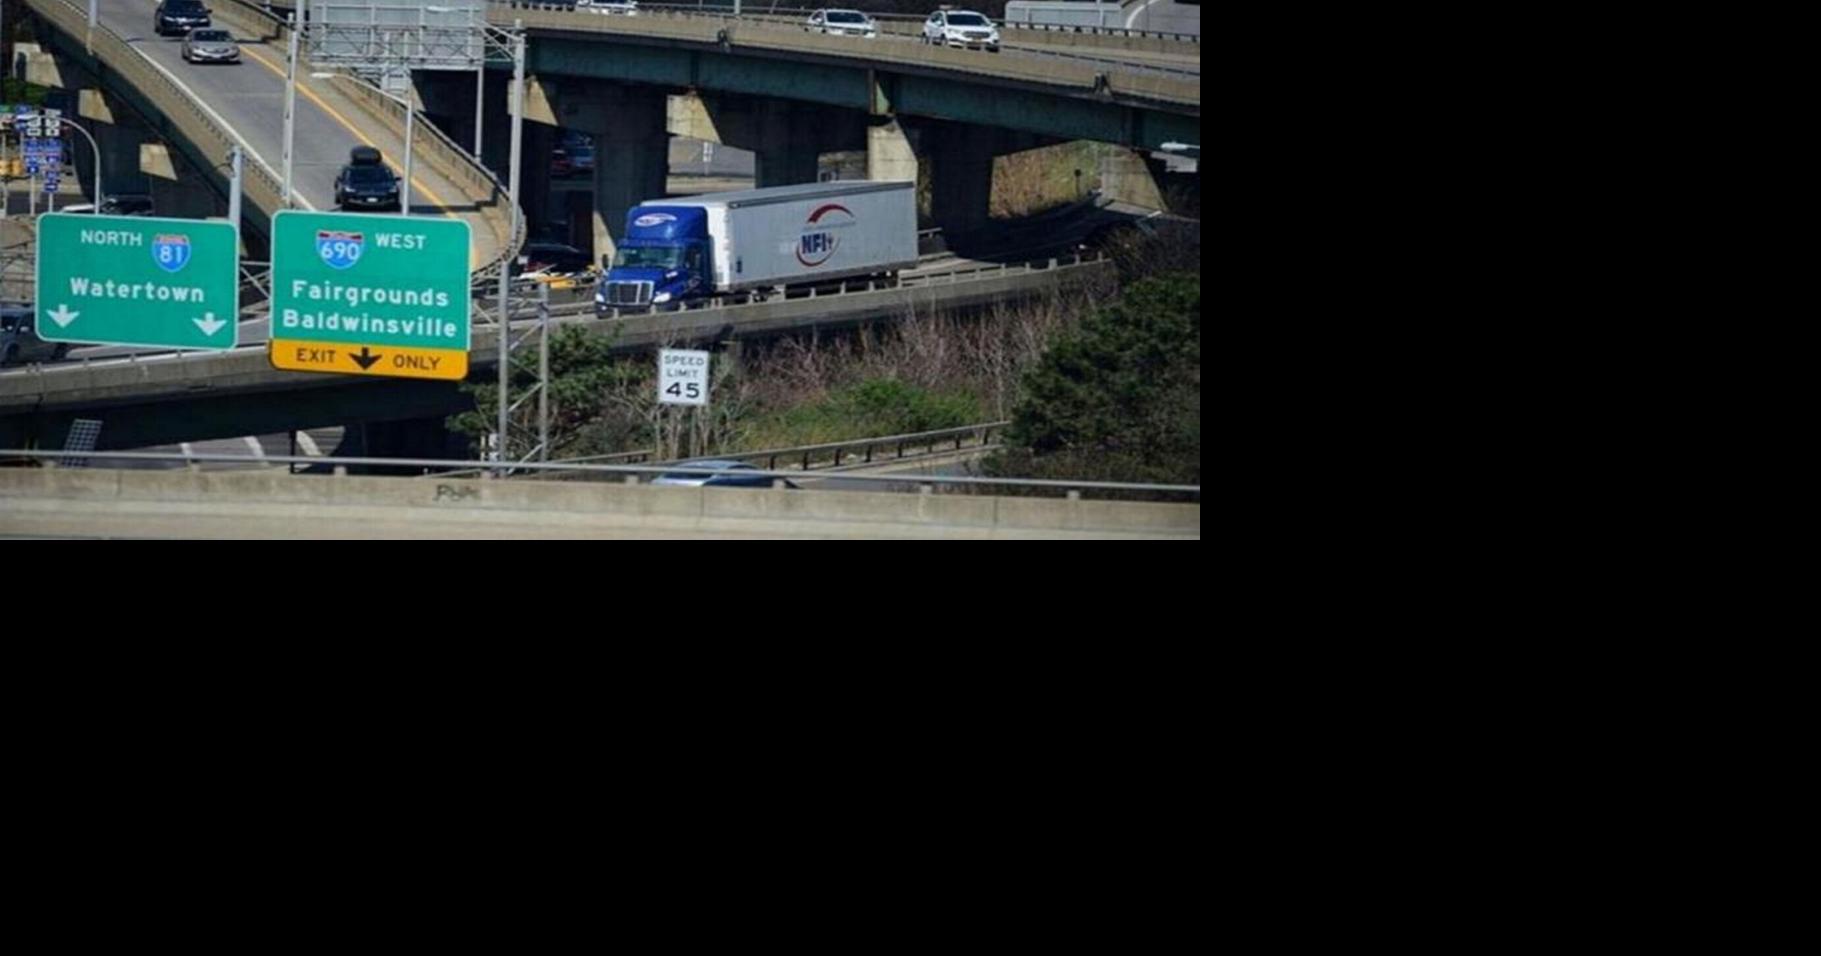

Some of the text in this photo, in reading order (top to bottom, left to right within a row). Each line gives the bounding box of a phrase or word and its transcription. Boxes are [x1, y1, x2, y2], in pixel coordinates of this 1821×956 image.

[80, 229, 143, 246] NORTH
[375, 232, 427, 250] WEST
[801, 232, 827, 255] NFI
[159, 245, 183, 264] 81
[320, 241, 360, 261] 690
[69, 277, 205, 303] Watertown
[292, 279, 449, 307] Fairgrounds
[282, 308, 457, 338] Baldwinsville
[296, 347, 441, 371] EXIT ONLY
[664, 354, 705, 367] SPEED
[666, 367, 699, 378] LIMIT
[665, 381, 700, 399] 45
